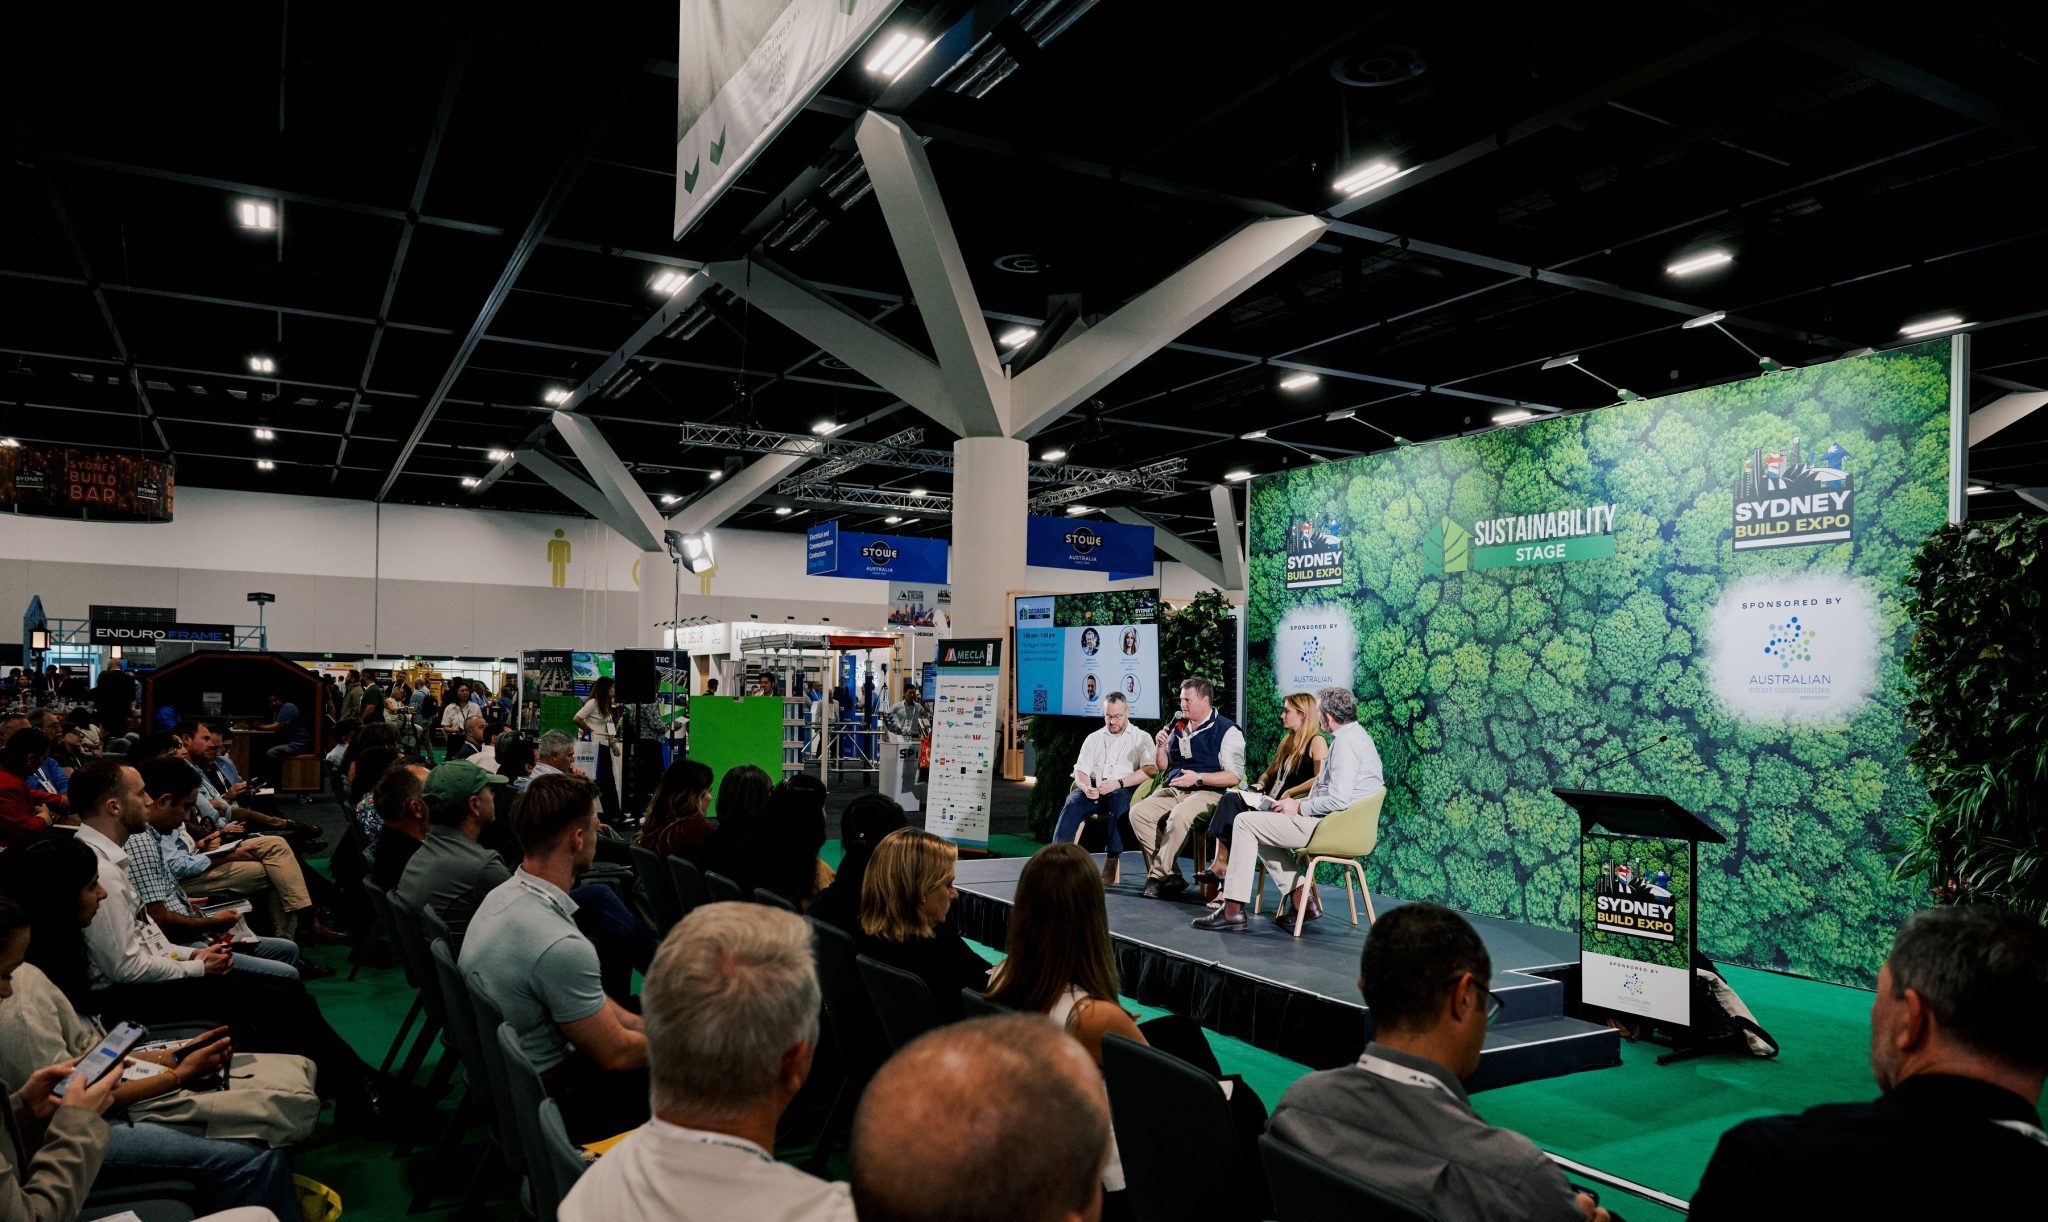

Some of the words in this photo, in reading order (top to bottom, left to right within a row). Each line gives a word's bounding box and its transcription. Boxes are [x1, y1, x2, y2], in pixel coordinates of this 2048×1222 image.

[69, 459, 117, 473] SYDNEY
[70, 471, 117, 486] BUILD
[70, 486, 117, 503] BAR
[137, 487, 157, 495] SYDNEY
[1735, 490, 1851, 522] SYDNEY
[1474, 504, 1617, 546] SUSTAINABILITY
[1735, 521, 1790, 538] BUILD
[1796, 514, 1850, 532] EXPO
[1065, 534, 1102, 546] STOWE
[862, 547, 898, 558] STOWE
[1068, 554, 1097, 562] AUSTRALIA
[1515, 543, 1566, 562] STAGE
[1287, 551, 1342, 570] SYDNEY
[1287, 570, 1314, 581] BUILD
[1316, 567, 1342, 578] EXPO
[1742, 598, 1818, 610] SPONSORED
[1825, 597, 1842, 605] BY
[957, 650, 985, 660] MECLA
[1294, 675, 1333, 683] AUSTRALIAN
[1750, 674, 1831, 685] AUSTRALIAN
[1749, 686, 1773, 694] smart
[1597, 895, 1674, 920] SYDNEY
[1597, 912, 1634, 926] BUILD
[1637, 918, 1674, 933] EXPO
[1609, 961, 1648, 973] SPONSORED
